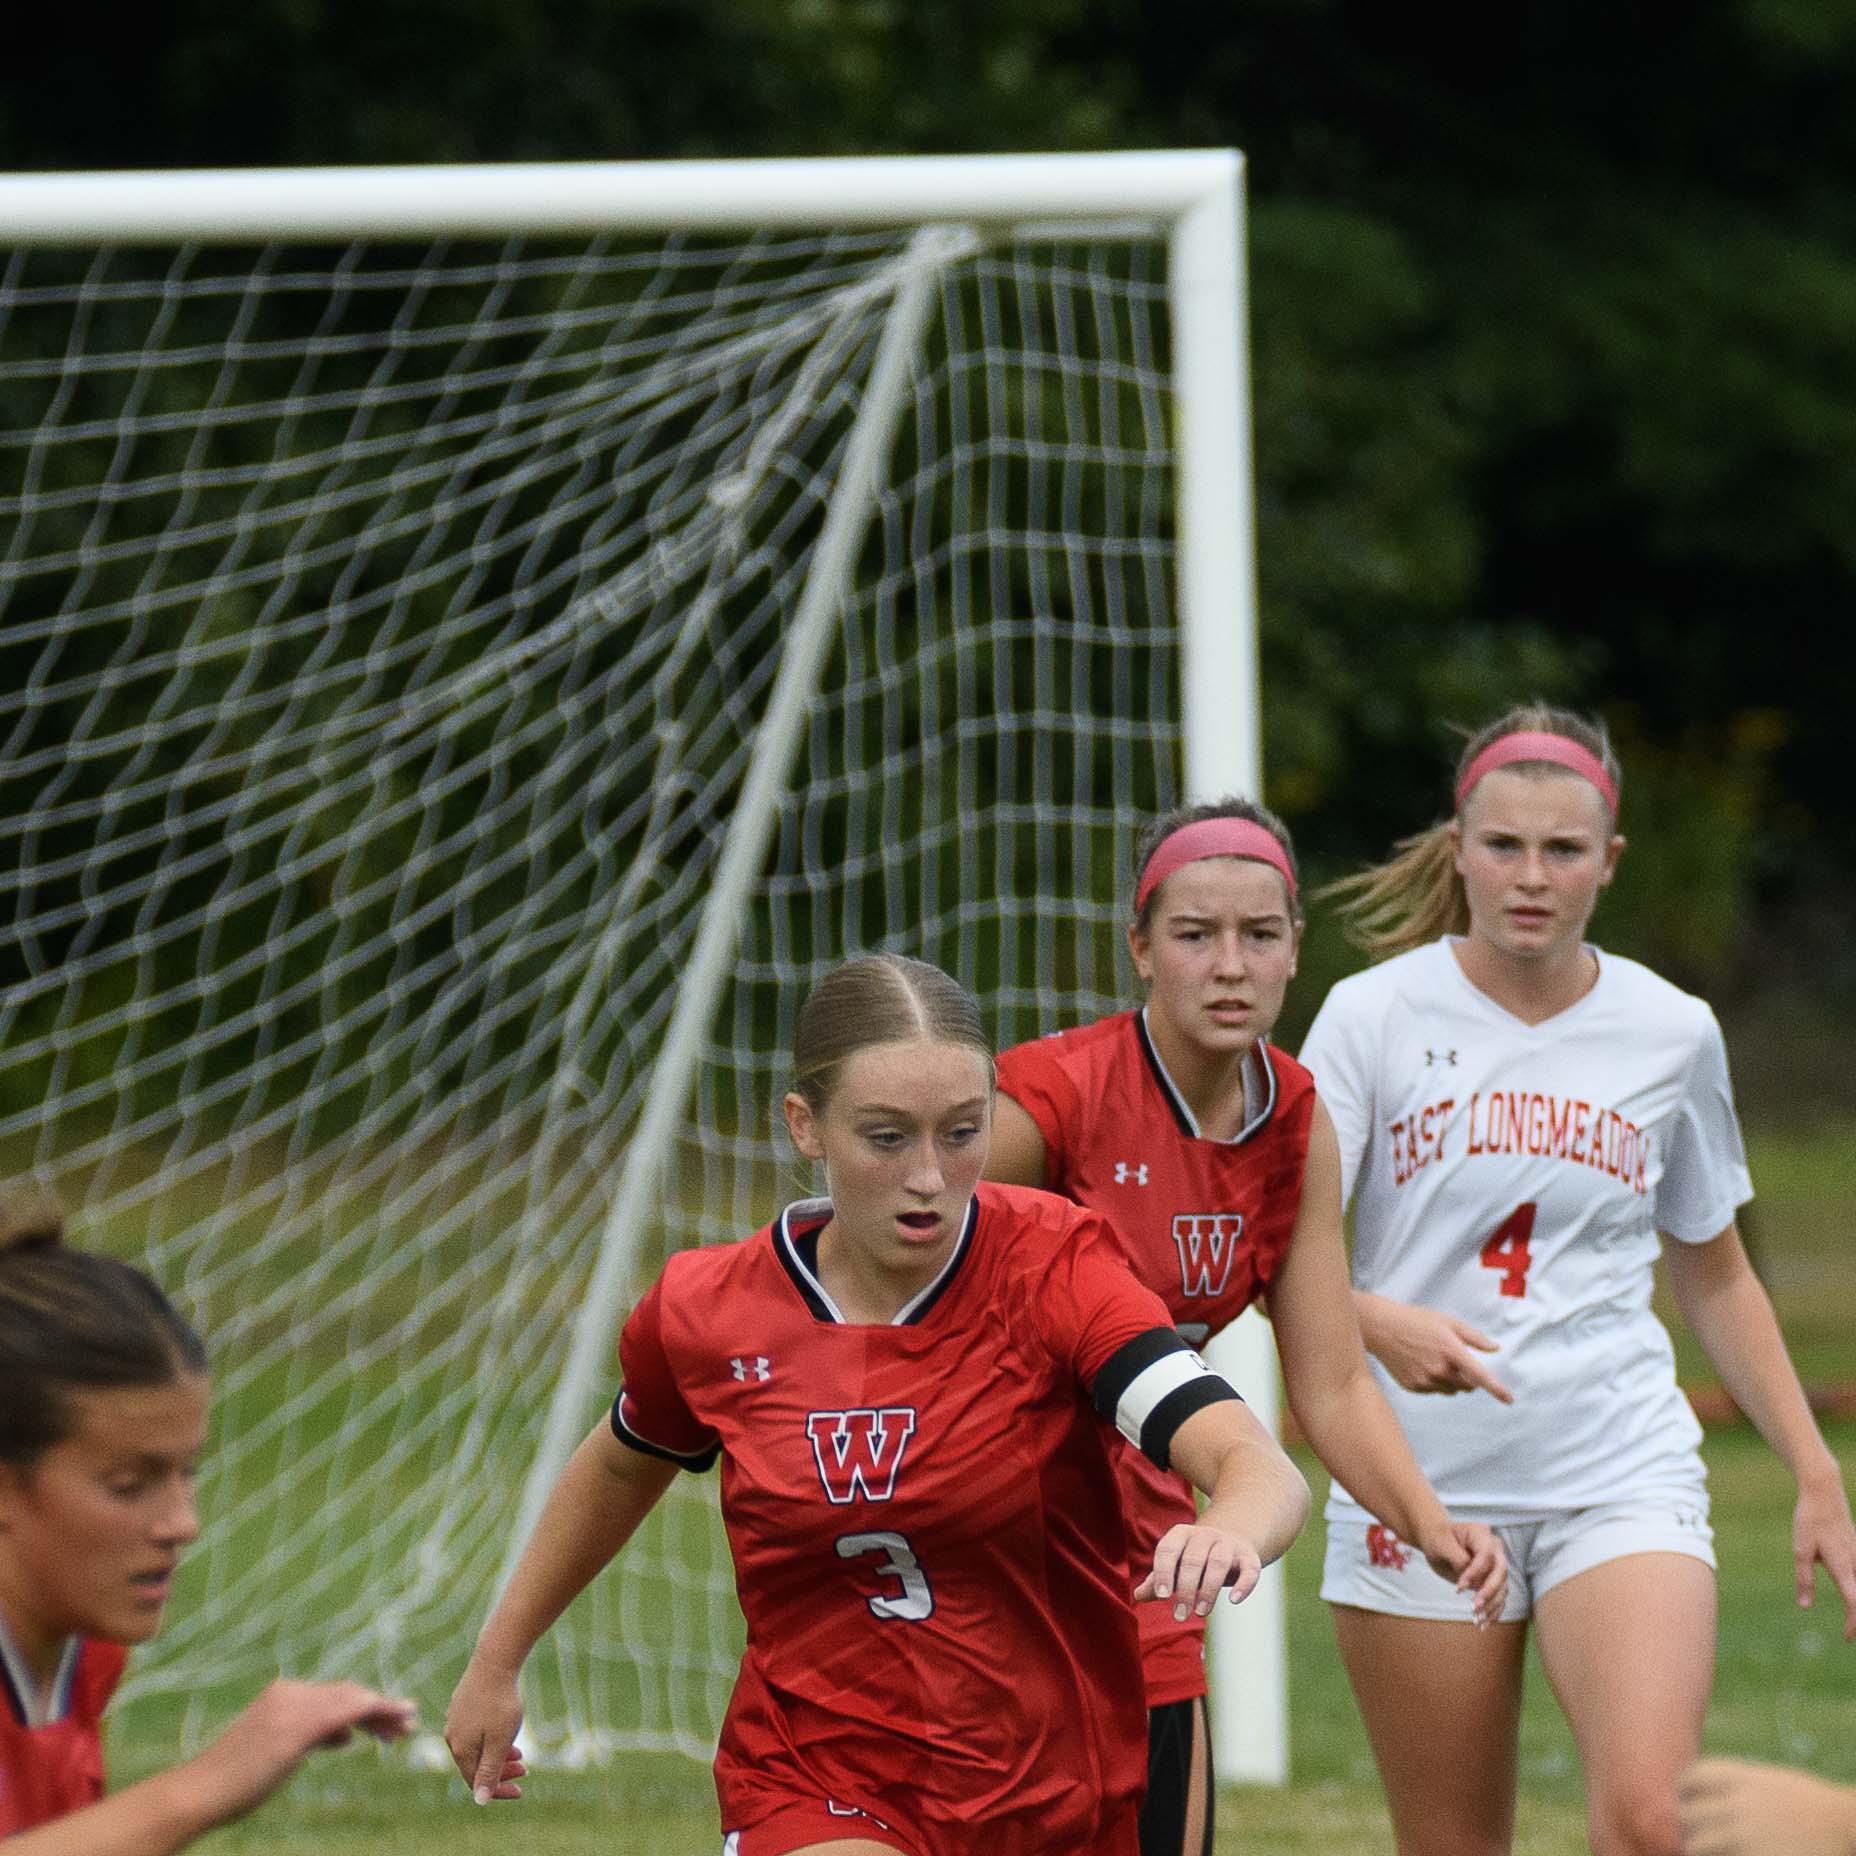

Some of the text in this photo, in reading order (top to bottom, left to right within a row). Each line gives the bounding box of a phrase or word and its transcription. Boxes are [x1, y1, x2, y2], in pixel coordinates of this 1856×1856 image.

[1390, 1098, 1455, 1188] EAST
[1171, 1213, 1242, 1297] W
[1479, 1202, 1538, 1298] 4
[805, 1406, 916, 1505] W
[833, 1530, 936, 1622] 3
